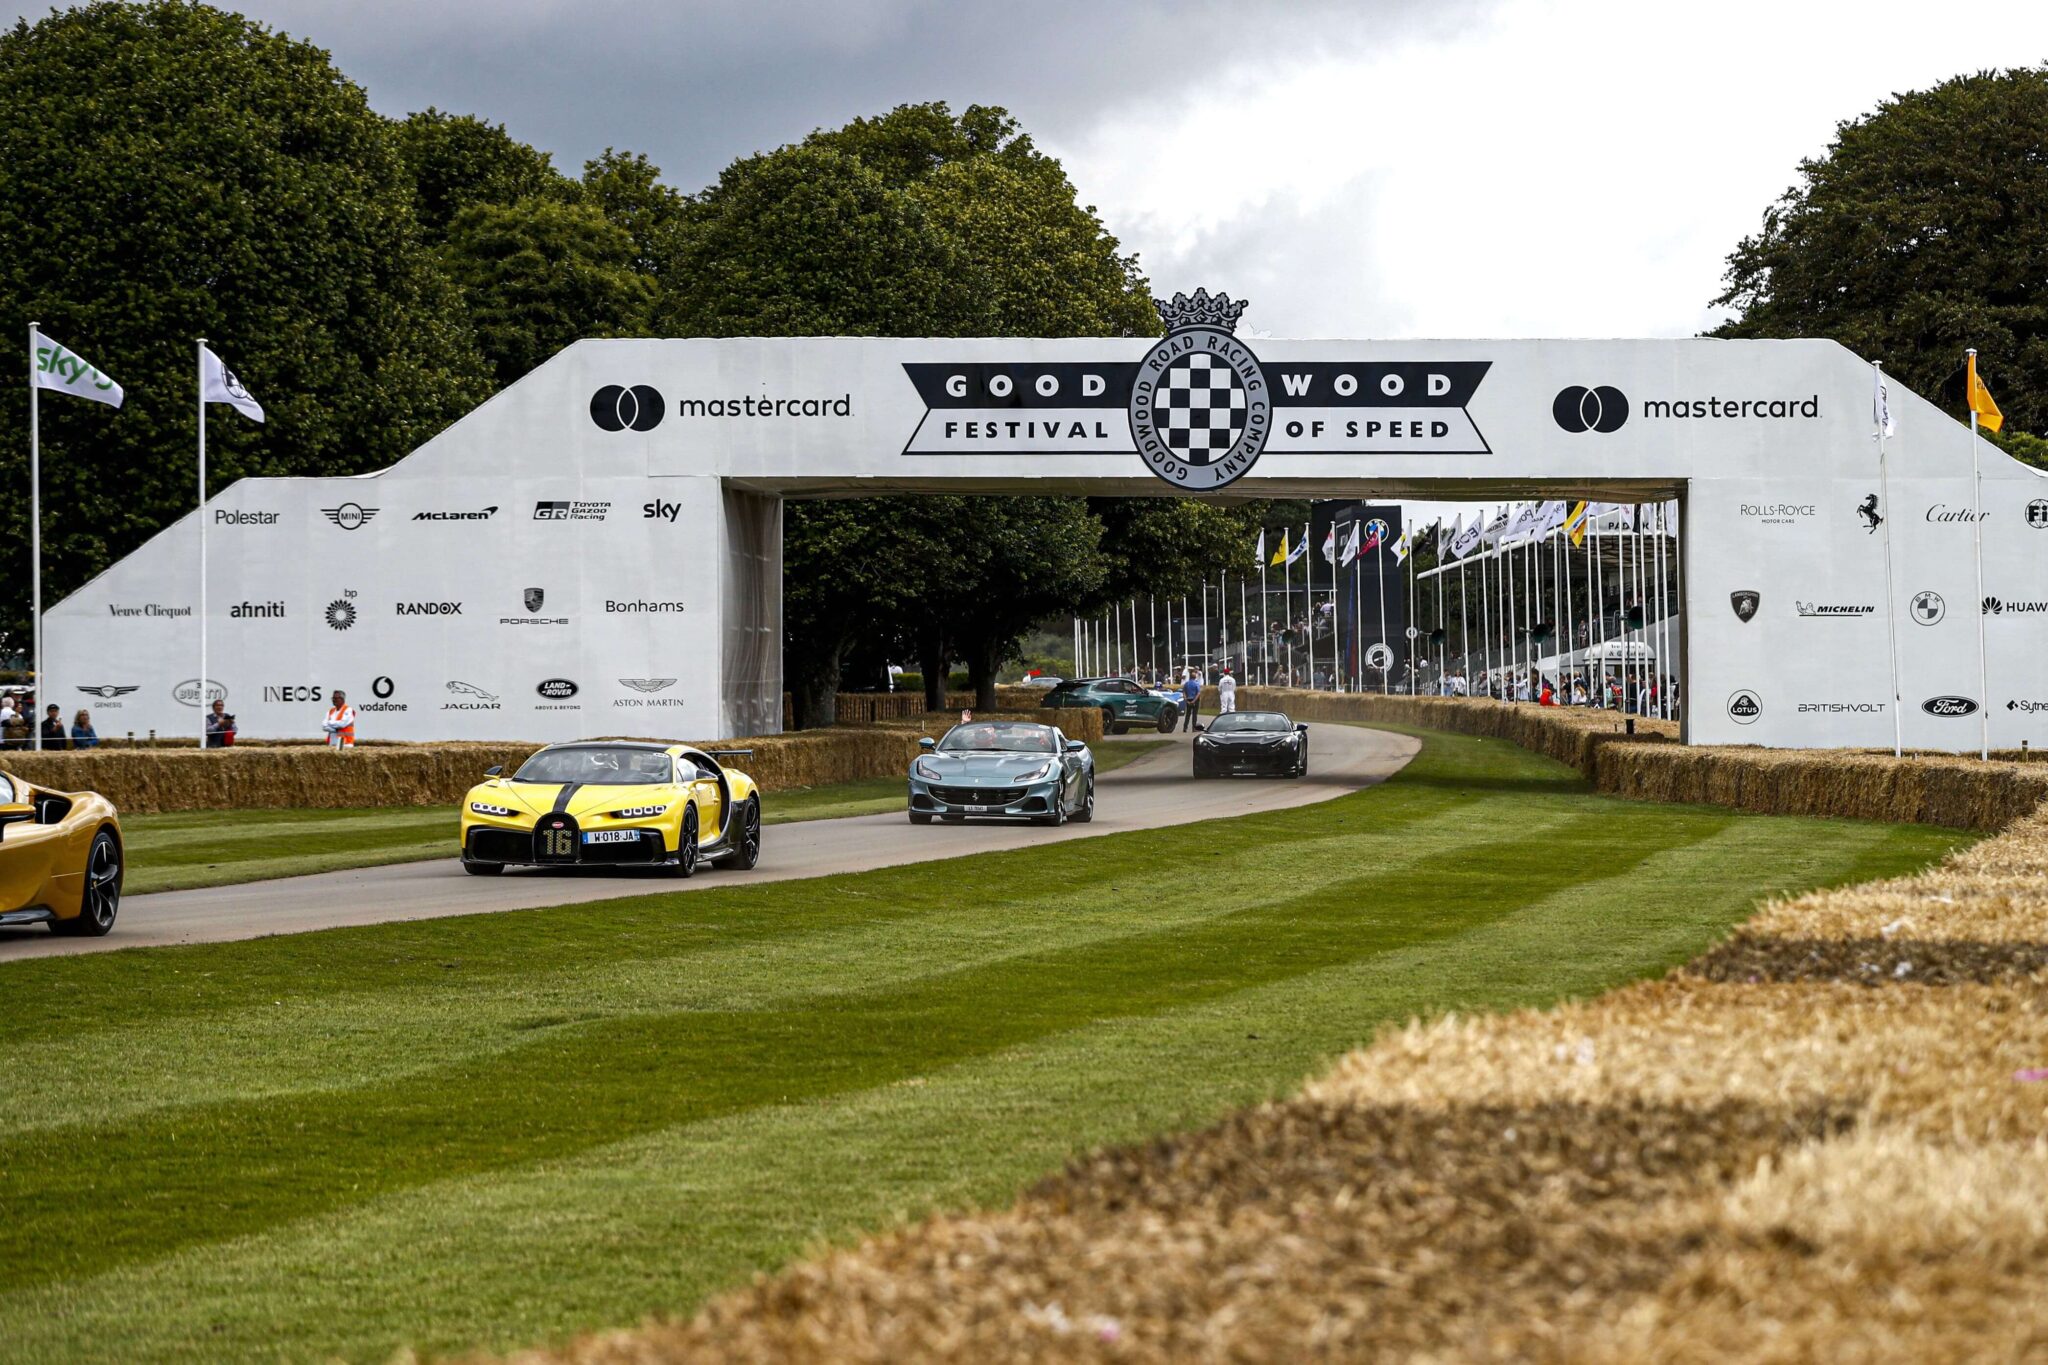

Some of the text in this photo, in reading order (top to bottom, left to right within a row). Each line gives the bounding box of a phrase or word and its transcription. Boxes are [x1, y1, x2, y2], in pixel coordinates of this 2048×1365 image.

[946, 373, 1452, 397] GOOD WOOD
[679, 393, 850, 417] mastercard
[1135, 335, 1266, 482] GOODWOOD ROAD RACING COMPANY
[1644, 394, 1818, 418] mastercard
[945, 421, 1449, 439] FESTIVAL OF SPEED
[340, 512, 361, 520] MINI
[412, 510, 489, 521] McLaren
[535, 508, 567, 519] GR
[643, 498, 682, 523] sky
[1740, 503, 1816, 516] ROLLS-ROYCE
[1926, 504, 1990, 522] Cartier
[215, 509, 280, 525] Polestar
[570, 513, 605, 521] Racing
[344, 588, 358, 600] bp
[1915, 593, 1940, 603] BMW
[109, 604, 191, 619] Veuve Clicquot
[230, 601, 285, 618] afiniti
[396, 602, 462, 615] RANDOX
[605, 599, 684, 613] Bonhams
[1817, 605, 1875, 613] MICHELIN
[264, 686, 322, 702] INEOS
[94, 701, 122, 709] GENESIS
[359, 701, 408, 712] vodafone
[613, 698, 684, 707] ASTON MARTIN
[1797, 703, 1886, 713] BRITISHVOLT
[1933, 699, 1968, 714] Ford
[543, 829, 572, 855] 16
